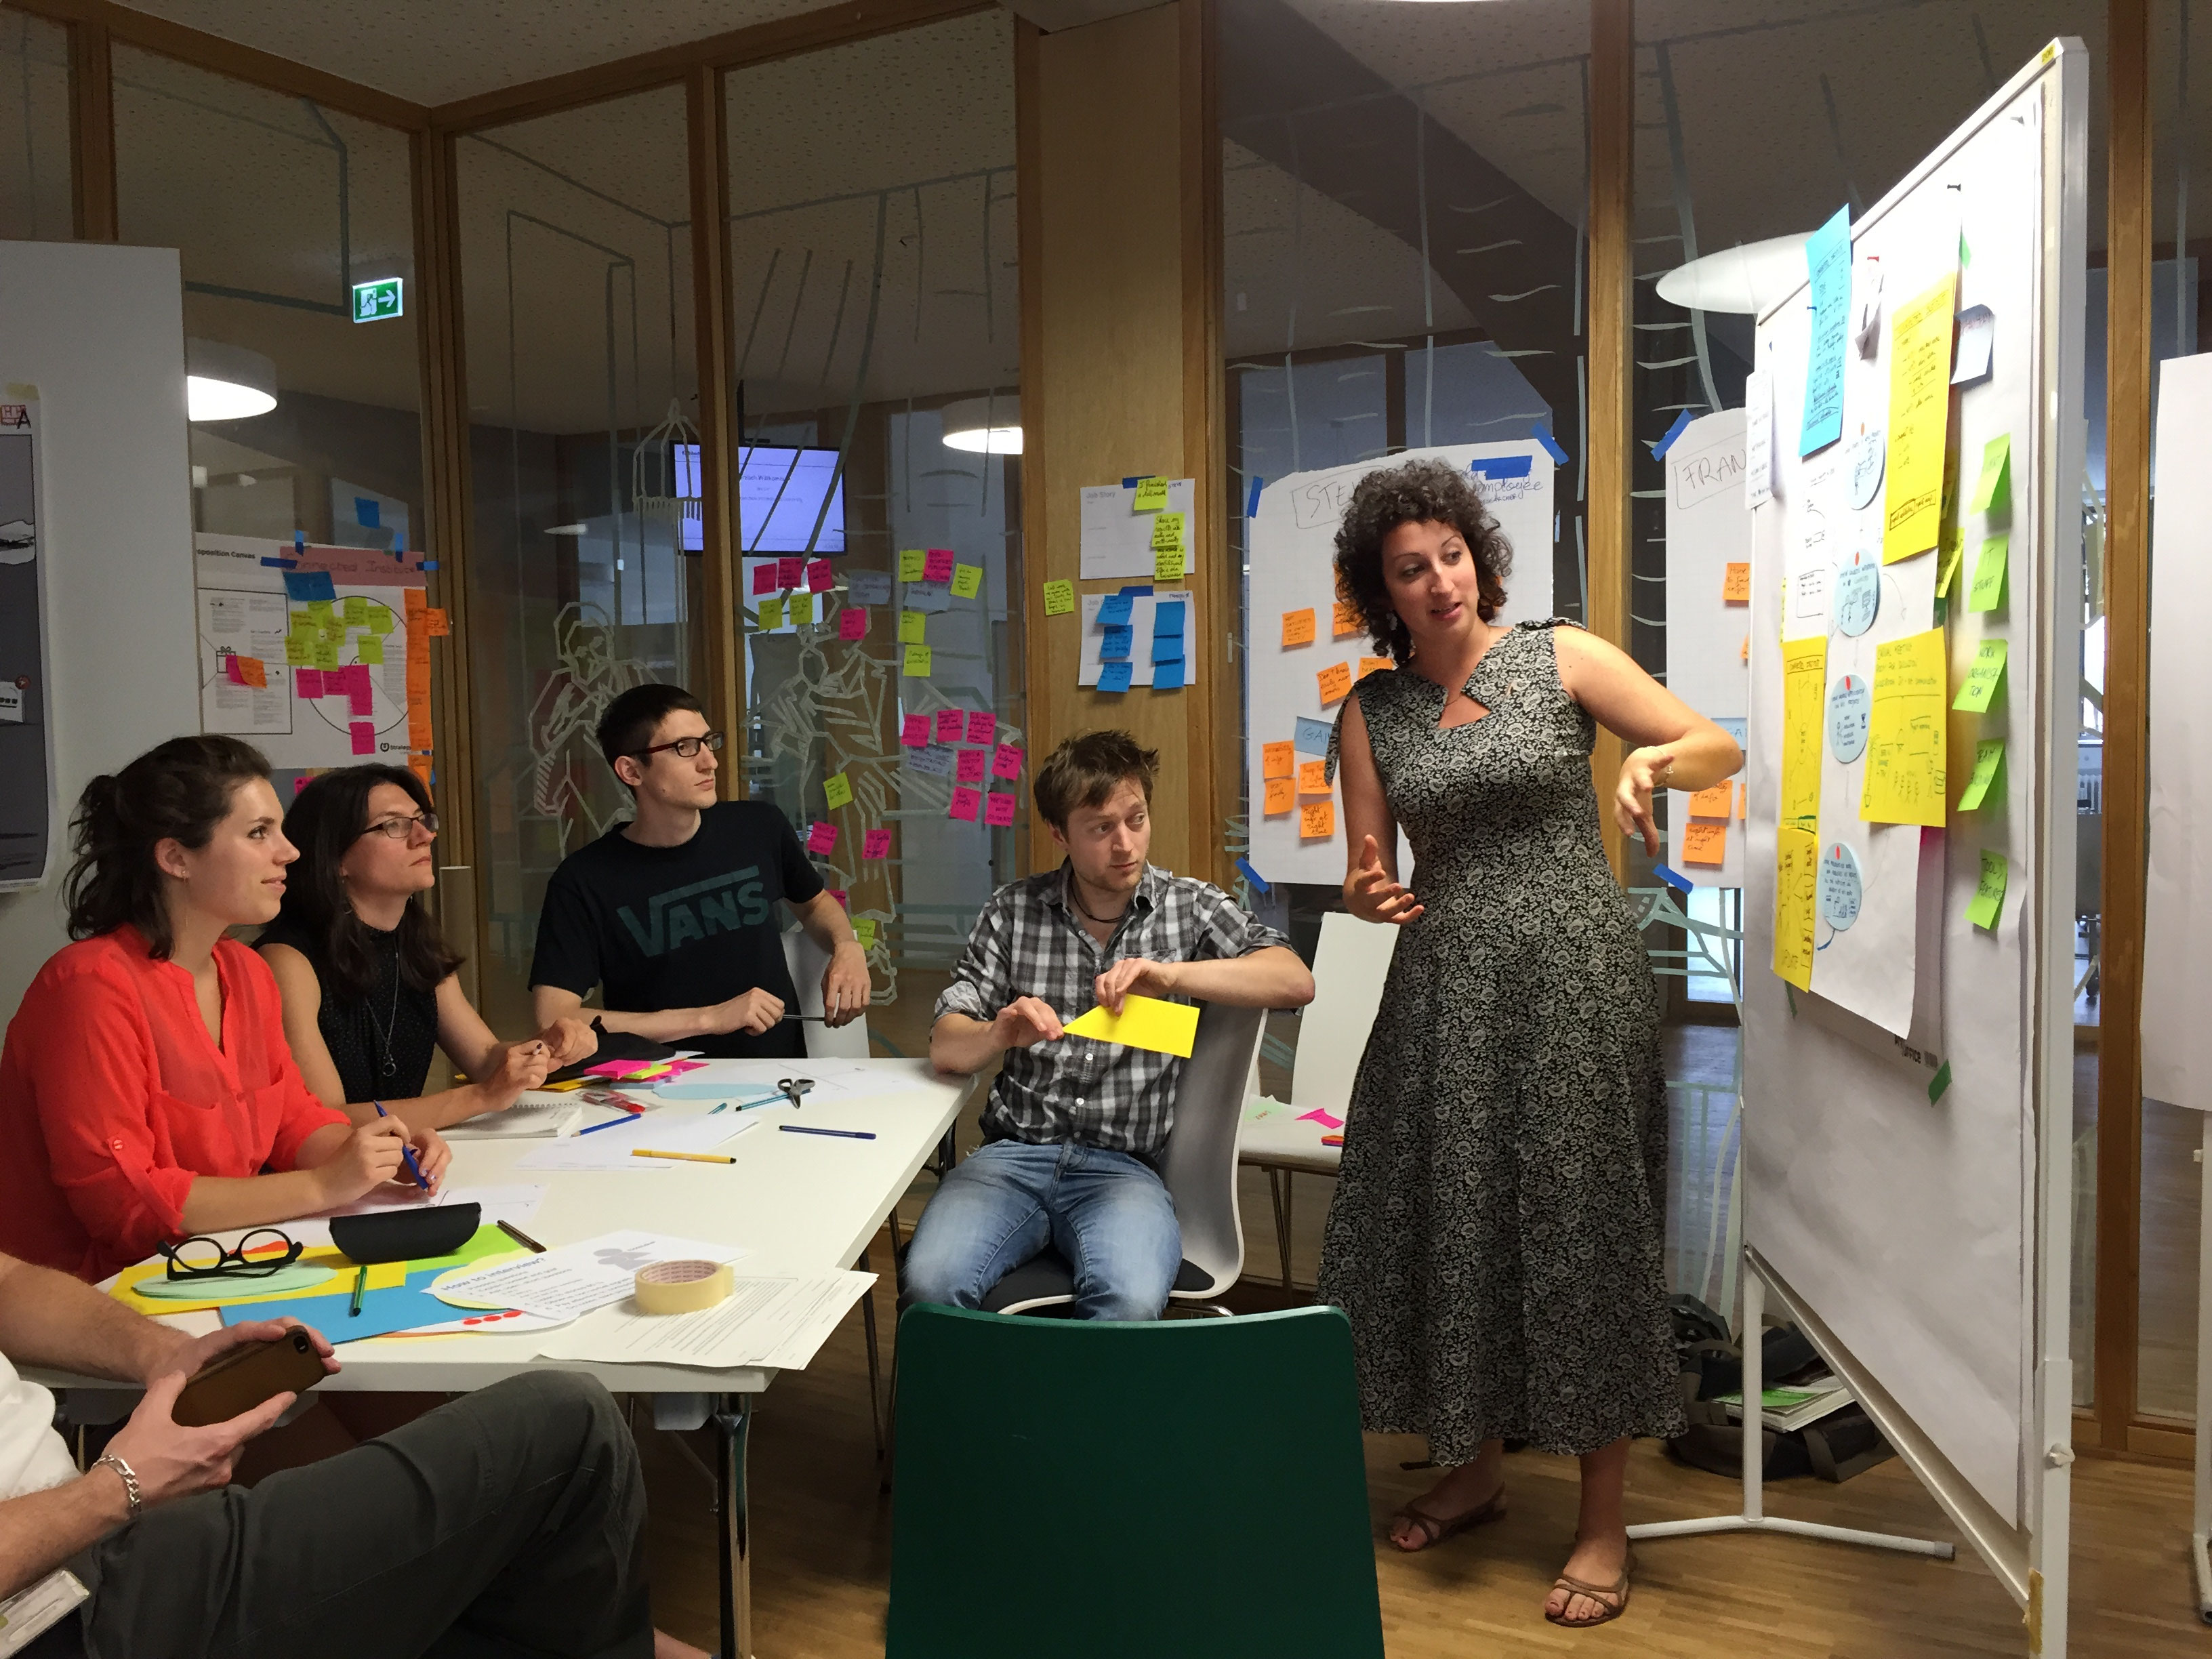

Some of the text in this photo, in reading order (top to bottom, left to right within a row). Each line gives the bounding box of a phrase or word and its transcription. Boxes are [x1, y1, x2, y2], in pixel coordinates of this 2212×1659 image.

[1099, 491, 1115, 499] Story
[231, 551, 255, 559] Canvas
[1981, 547, 1995, 567] IT
[1973, 575, 1995, 593] STUFF
[616, 865, 701, 957] VANS
[441, 1256, 547, 1292] How to interview?
